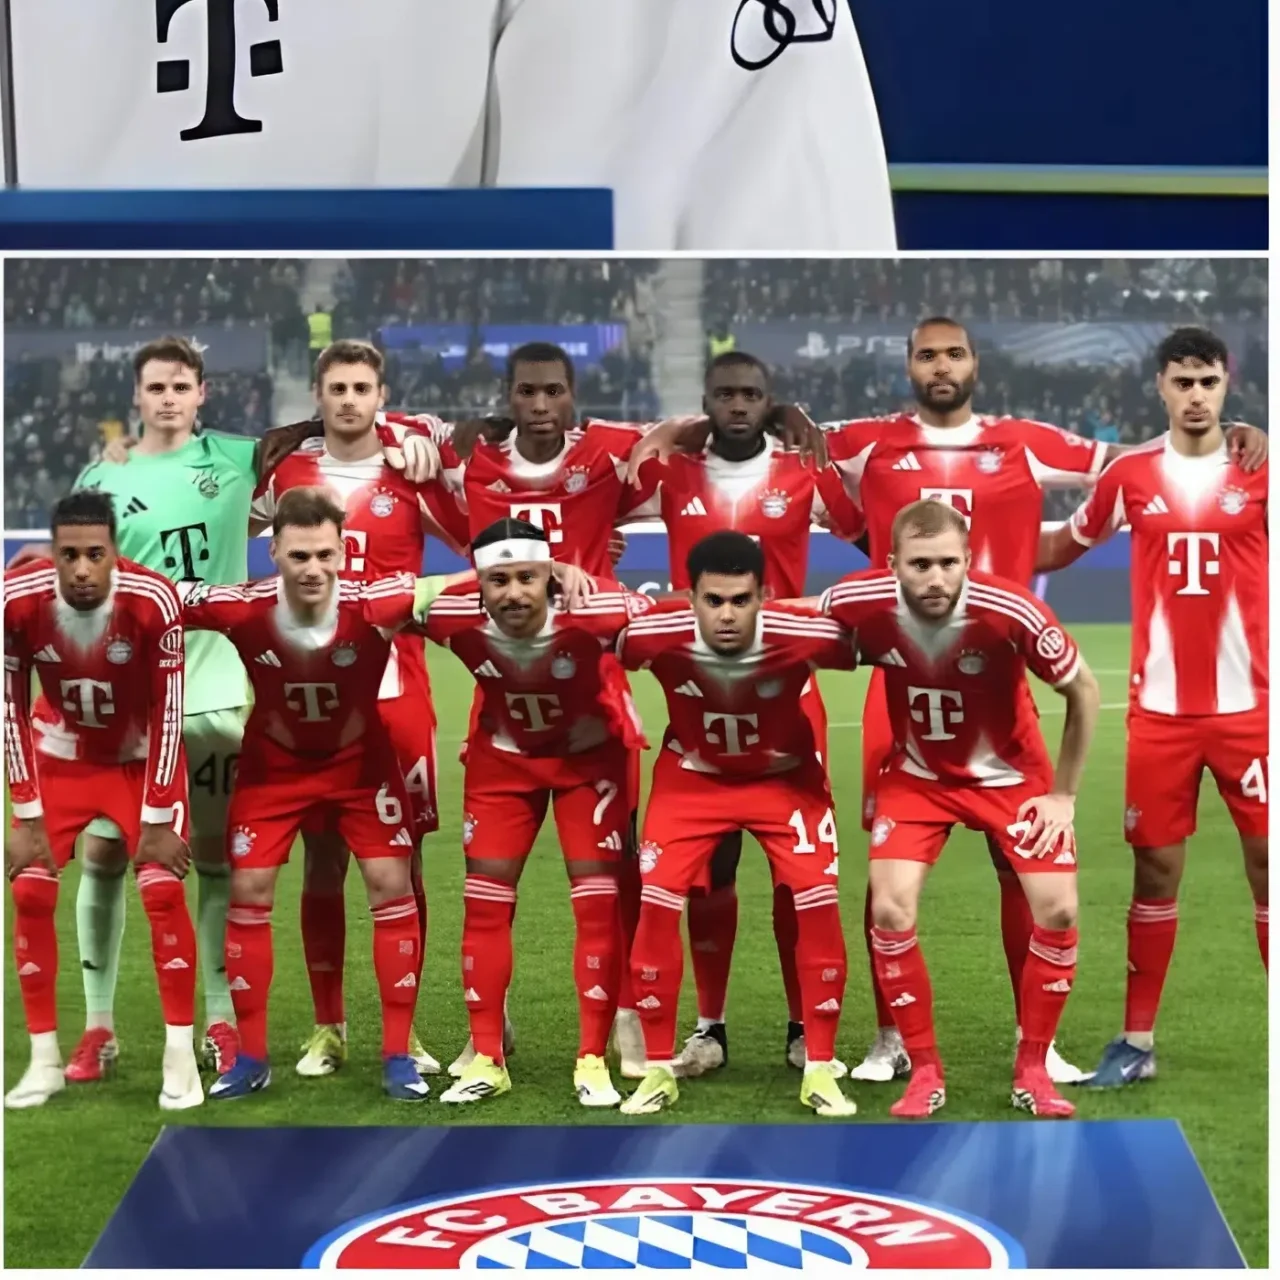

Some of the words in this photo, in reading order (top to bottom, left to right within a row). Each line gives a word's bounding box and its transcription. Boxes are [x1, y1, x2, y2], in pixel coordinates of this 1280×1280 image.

[375, 781, 403, 825] 6
[375, 1208, 508, 1250] FC
[521, 1185, 959, 1247] BAYERN
